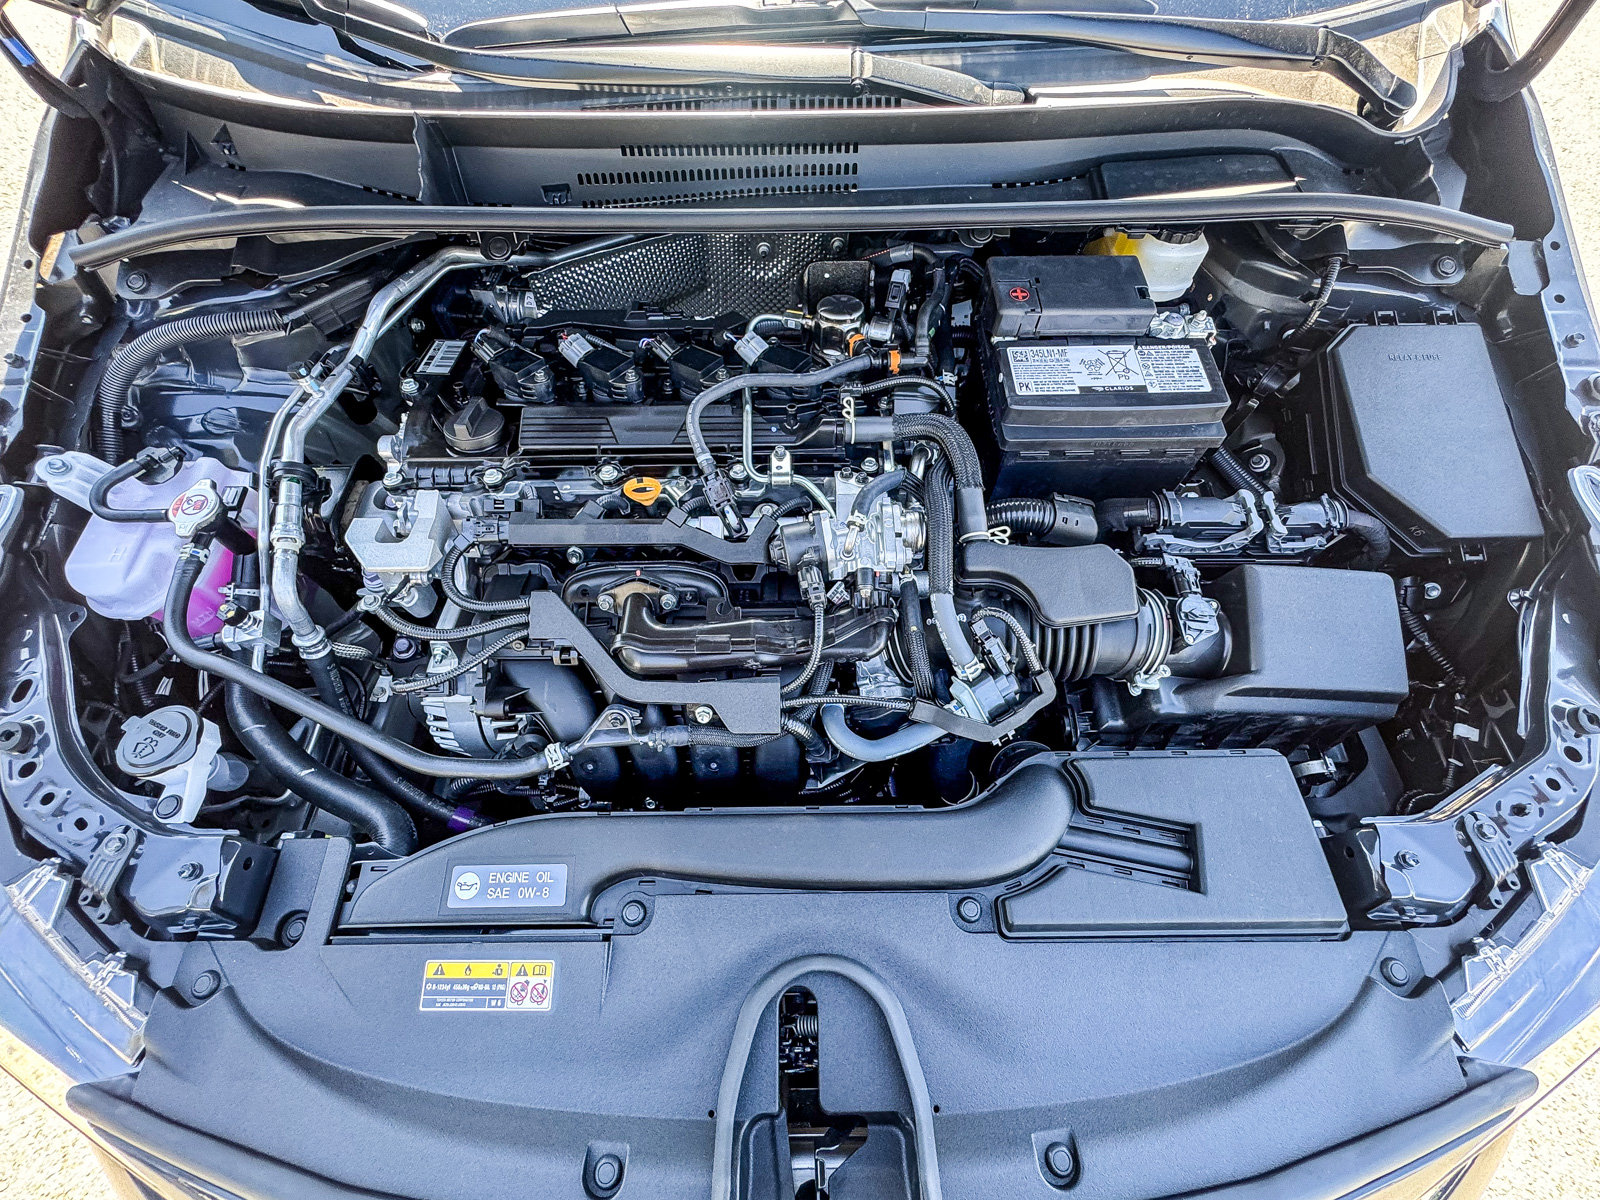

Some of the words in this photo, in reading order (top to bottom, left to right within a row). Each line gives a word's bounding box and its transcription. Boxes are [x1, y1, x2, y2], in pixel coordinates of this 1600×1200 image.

[1018, 381, 1032, 391] PK
[488, 872, 530, 884] ENGINE
[536, 871, 554, 883] OIL
[486, 887, 511, 899] SAE
[517, 887, 550, 899] 0W-8
